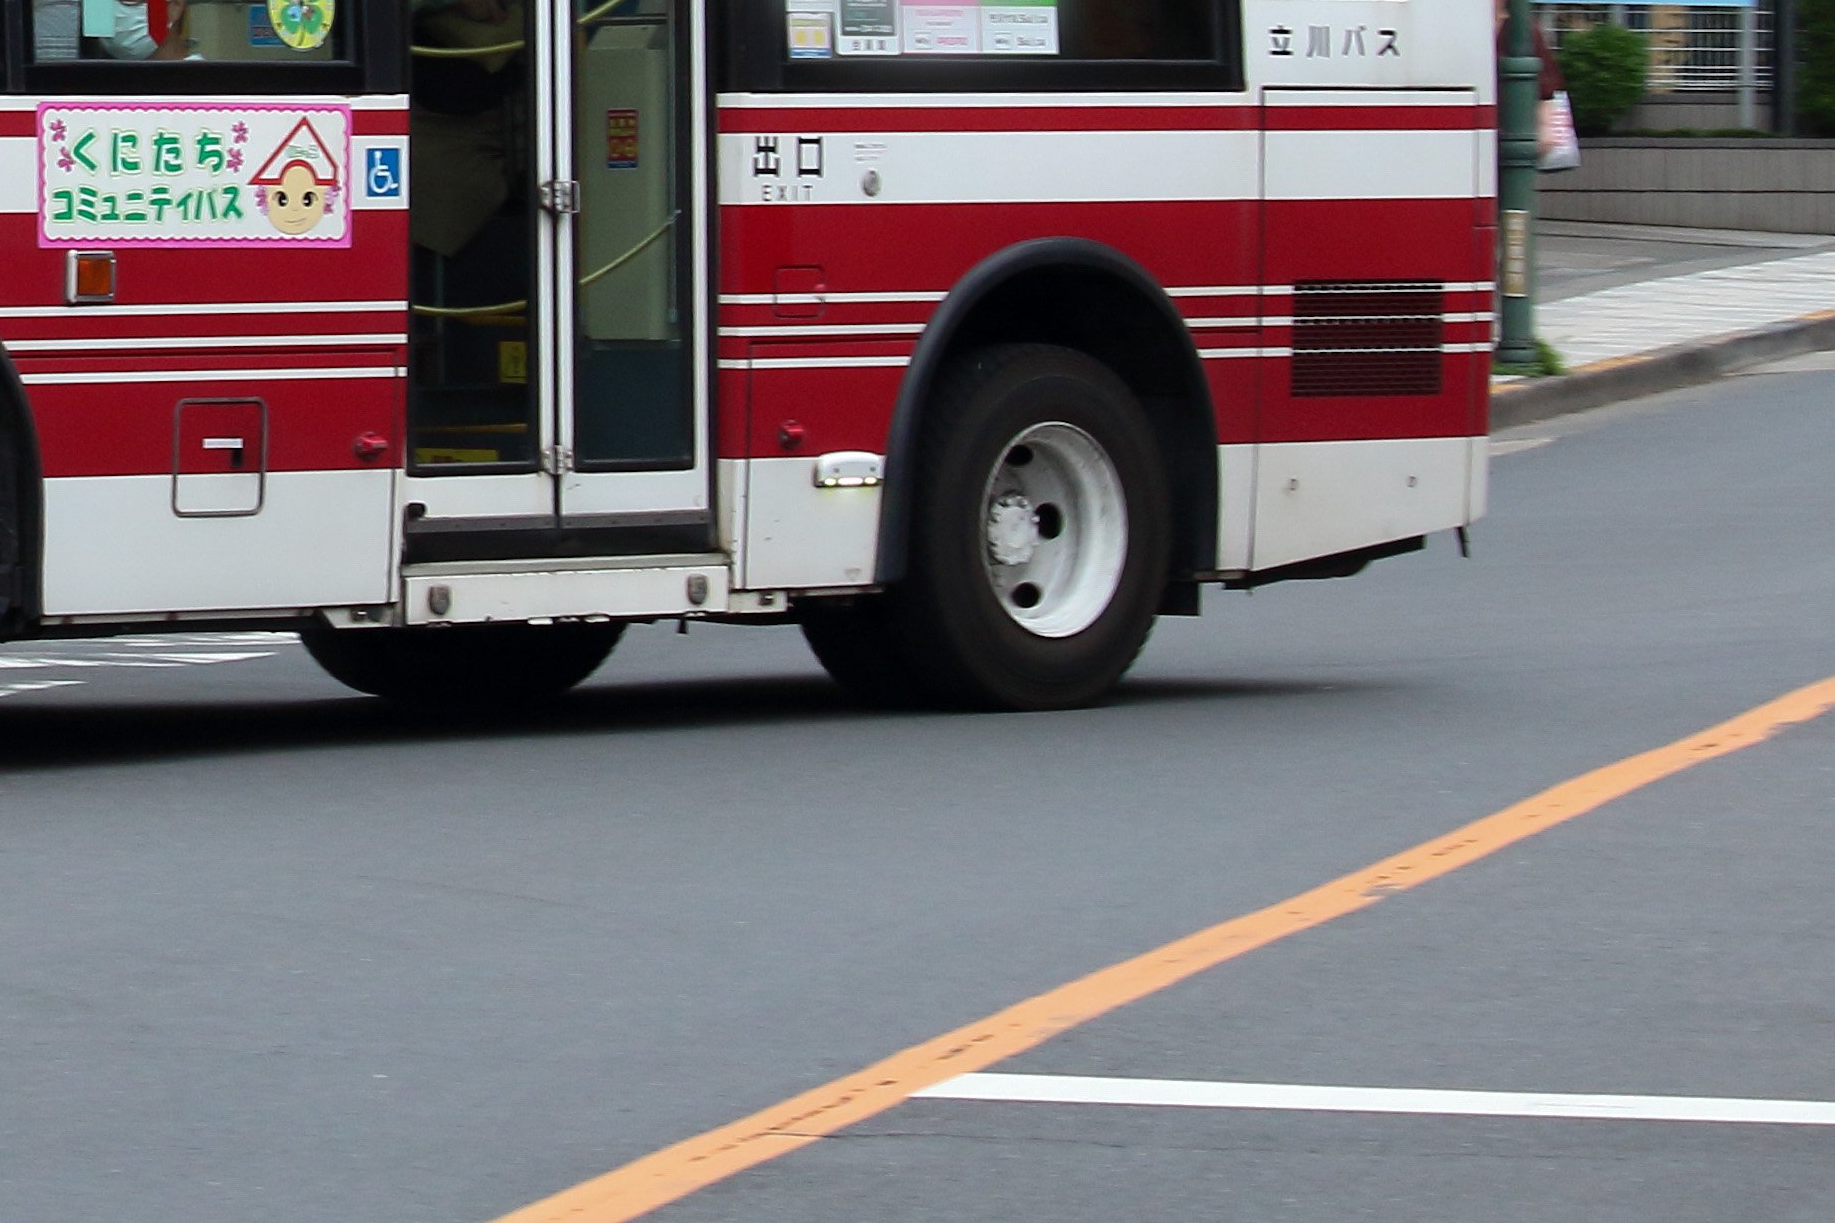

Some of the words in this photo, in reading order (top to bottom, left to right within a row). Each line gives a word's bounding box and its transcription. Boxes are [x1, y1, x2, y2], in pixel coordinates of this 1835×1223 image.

[1268, 25, 1402, 58] 立川バス
[72, 127, 227, 175] くにたち
[753, 135, 823, 178] 出口
[51, 184, 244, 224] コミュニティバス
[761, 184, 814, 202] EXIT
